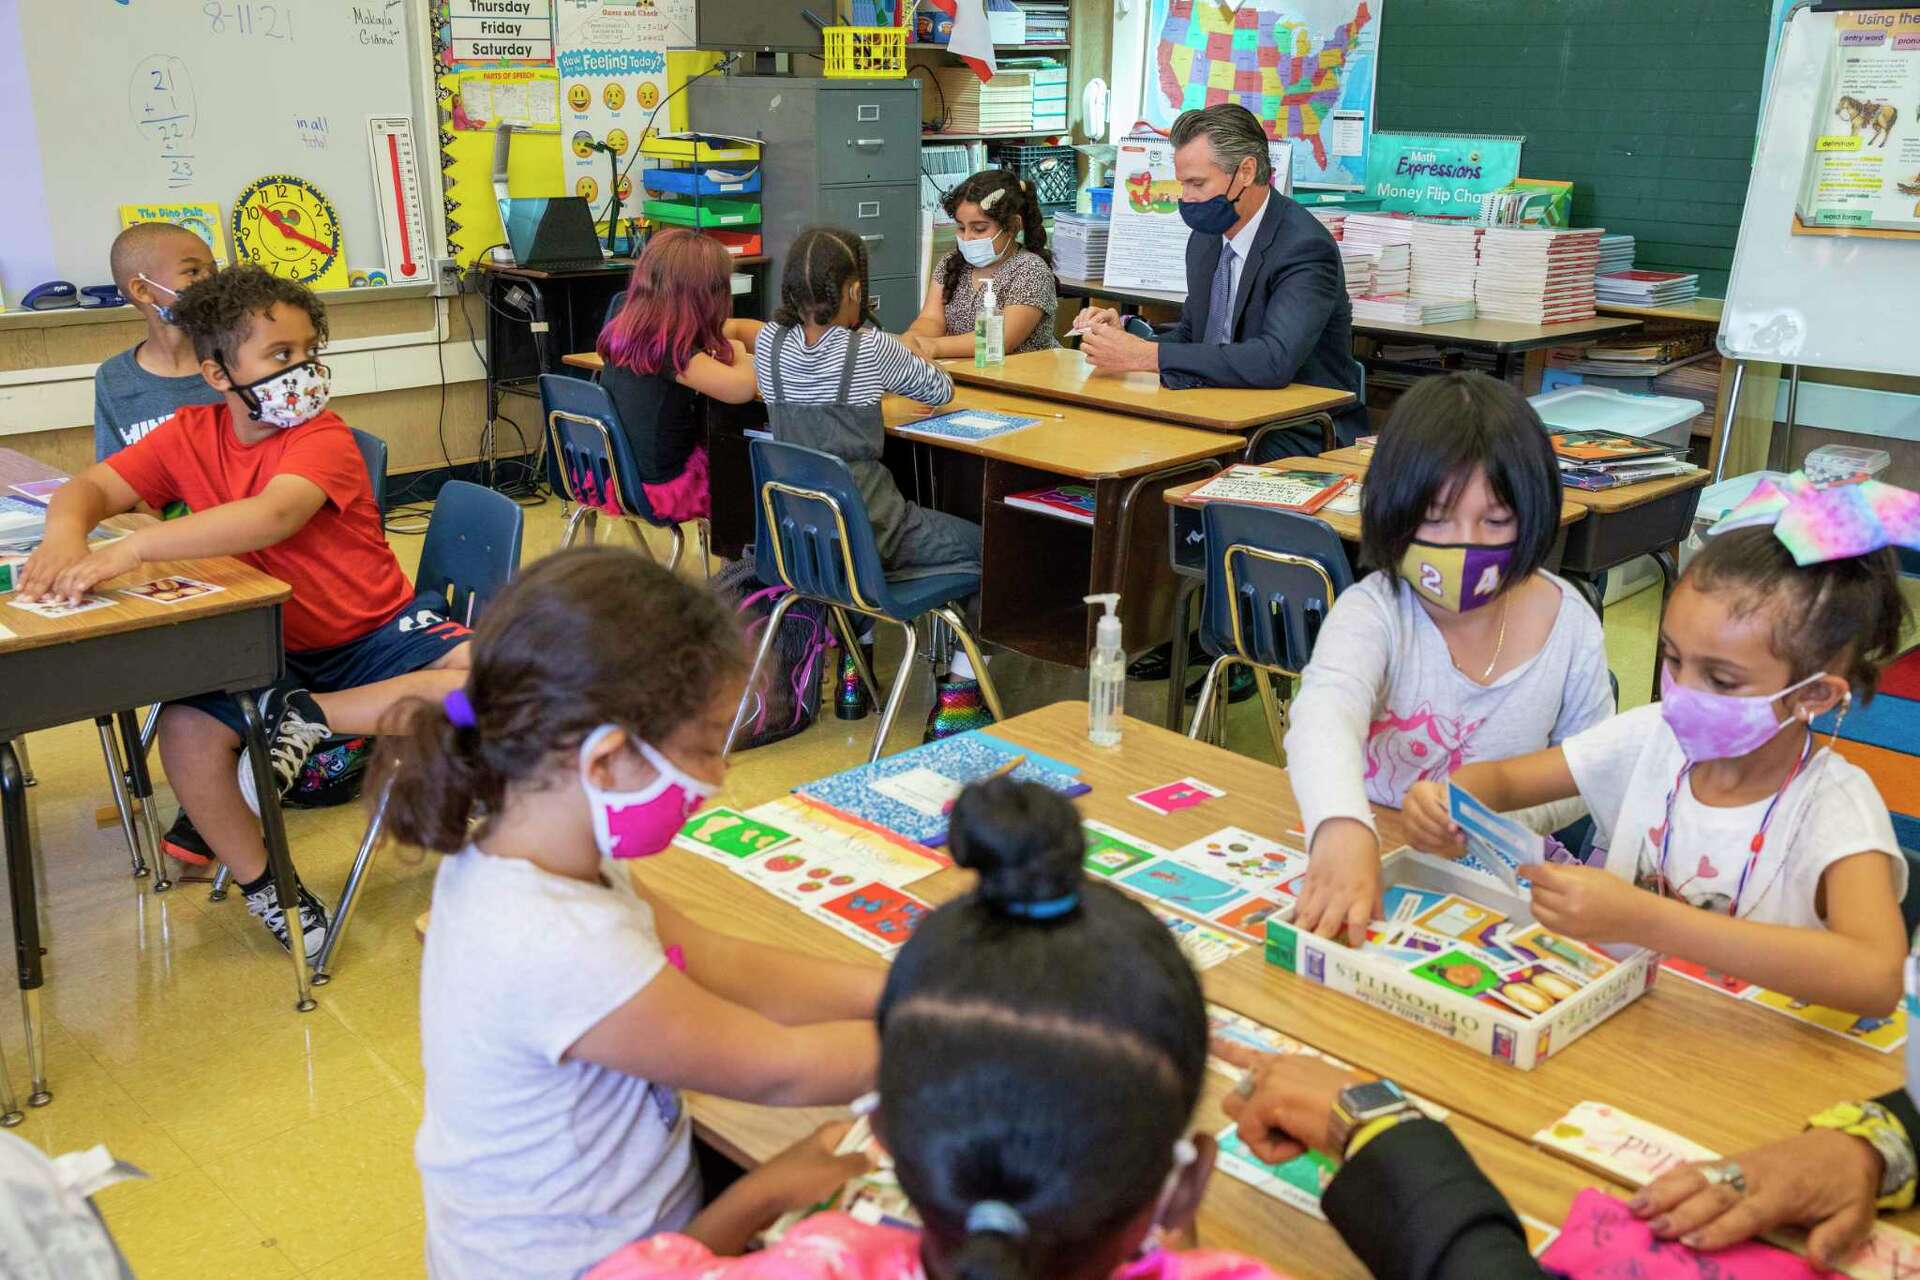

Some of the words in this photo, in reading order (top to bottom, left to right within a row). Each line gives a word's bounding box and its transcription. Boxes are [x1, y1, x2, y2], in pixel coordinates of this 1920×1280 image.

[471, 0, 530, 15] Thursday
[1857, 13, 1895, 27] Using
[481, 21, 522, 36] Friday
[1843, 33, 1863, 42] entry
[473, 43, 532, 57] Saturday
[583, 54, 628, 70] Feeling
[629, 55, 661, 69] Today?
[484, 72, 502, 80] PARTS
[1411, 151, 1437, 163] Math
[1396, 156, 1483, 180] Expressions
[259, 190, 269, 203] 11
[275, 184, 288, 198] 12
[299, 188, 304, 202] 1
[1377, 183, 1424, 203] Money
[1427, 186, 1451, 205] Flip
[1454, 187, 1485, 204] Cha
[245, 206, 260, 221] 10
[314, 203, 324, 217] 2
[242, 228, 251, 241] 9
[323, 222, 333, 236] 3
[251, 247, 261, 261] 8
[310, 258, 319, 272] 5
[290, 266, 300, 279] 6
[119, 413, 175, 445] MIN
[1335, 962, 1480, 1033] OPPOSITES
